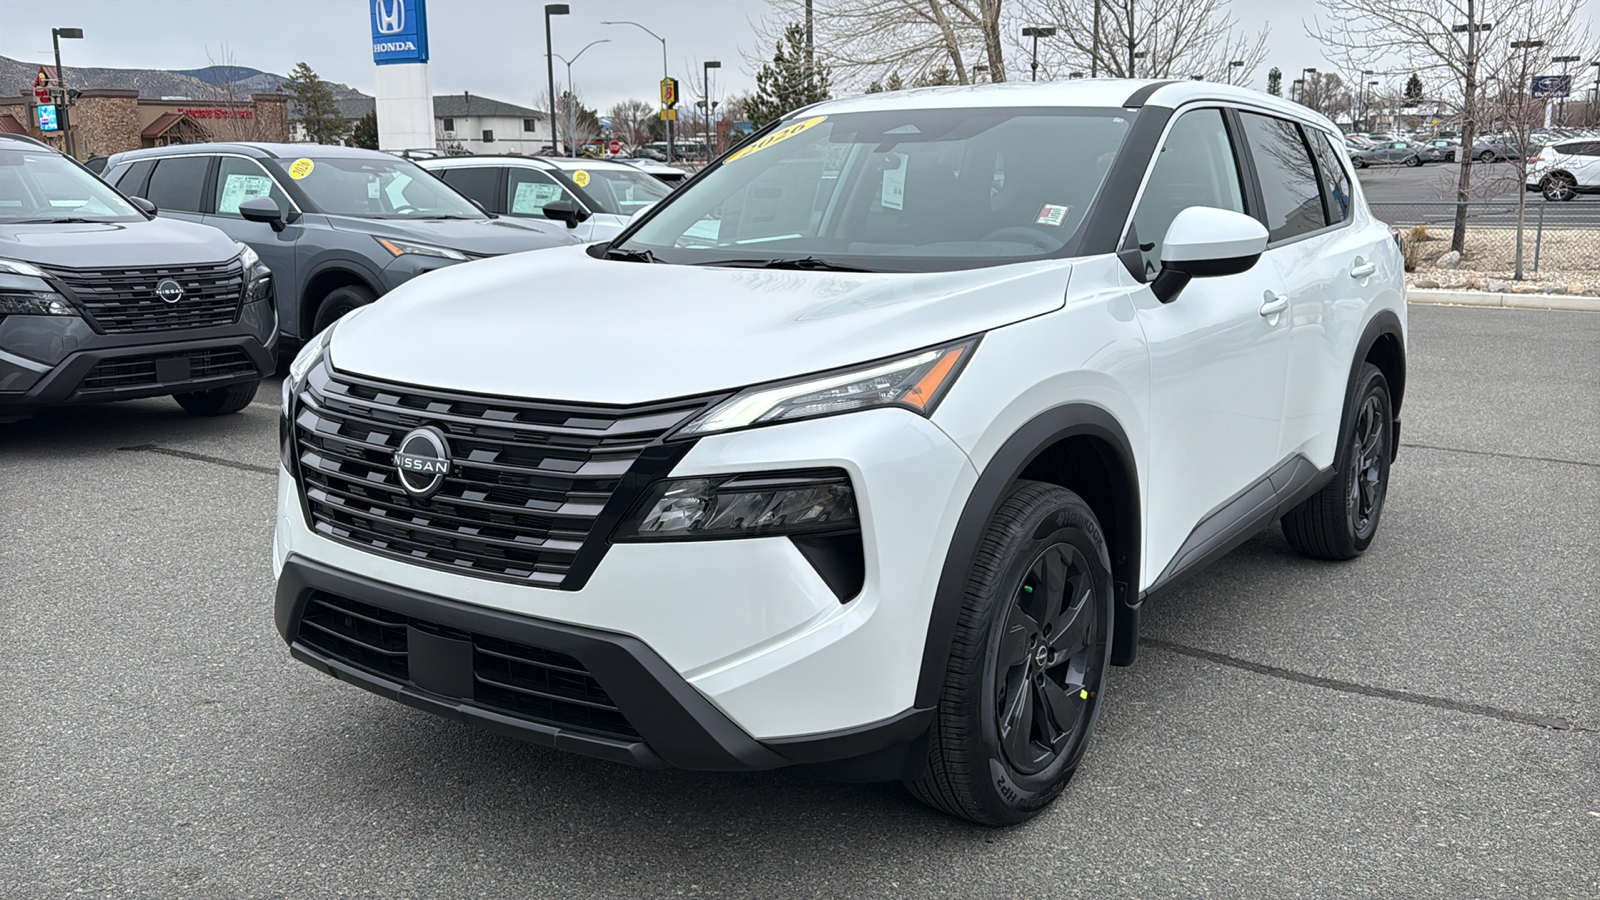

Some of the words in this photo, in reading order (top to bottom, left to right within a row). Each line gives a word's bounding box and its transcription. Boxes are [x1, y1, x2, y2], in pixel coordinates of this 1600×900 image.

[373, 41, 417, 53] HONDA
[743, 123, 806, 157] 2026
[292, 160, 311, 177] 2026
[393, 454, 448, 473] NISSAN
[997, 775, 1017, 803] HP2
